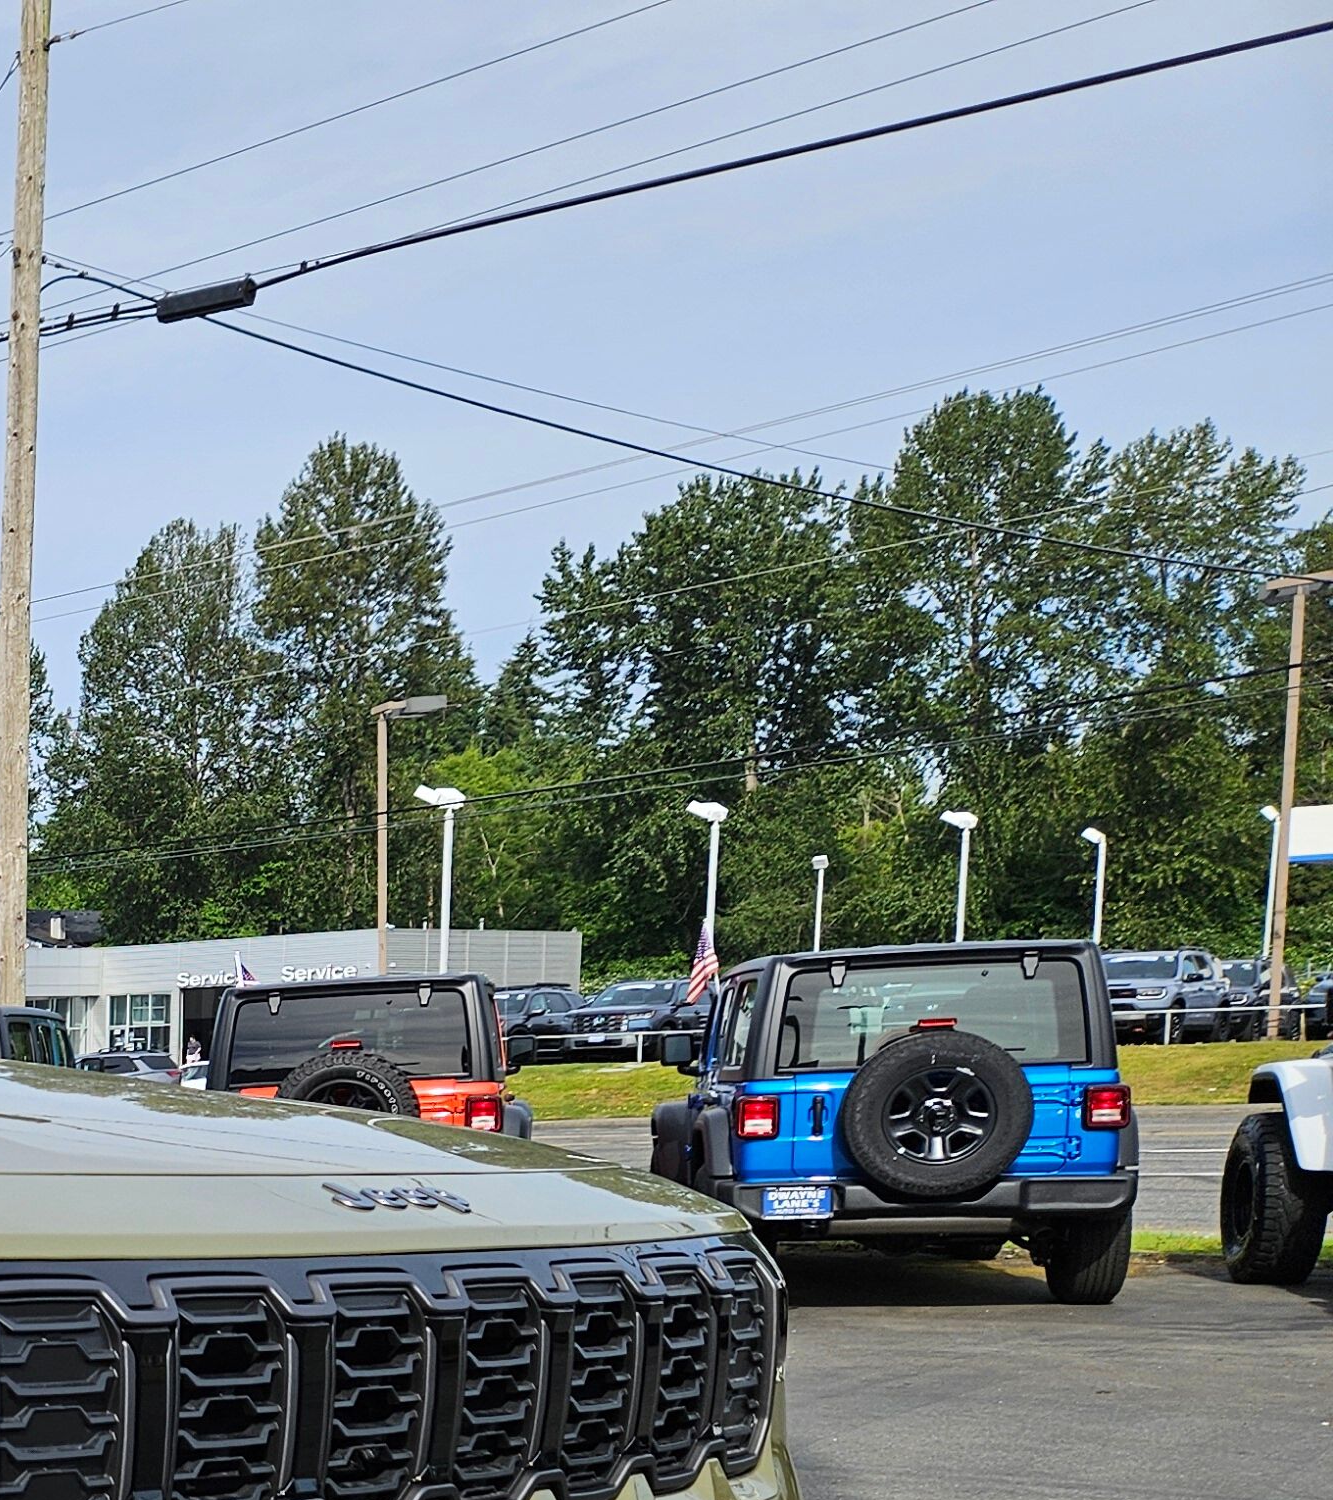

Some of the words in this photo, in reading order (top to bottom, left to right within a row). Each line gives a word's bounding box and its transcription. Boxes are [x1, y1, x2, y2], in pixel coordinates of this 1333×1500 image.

[176, 970, 240, 987] Servic
[282, 964, 357, 982] Service
[322, 1182, 472, 1213] Jeep
[767, 1190, 826, 1201] DWAYNE
[773, 1199, 821, 1209] LANE'S
